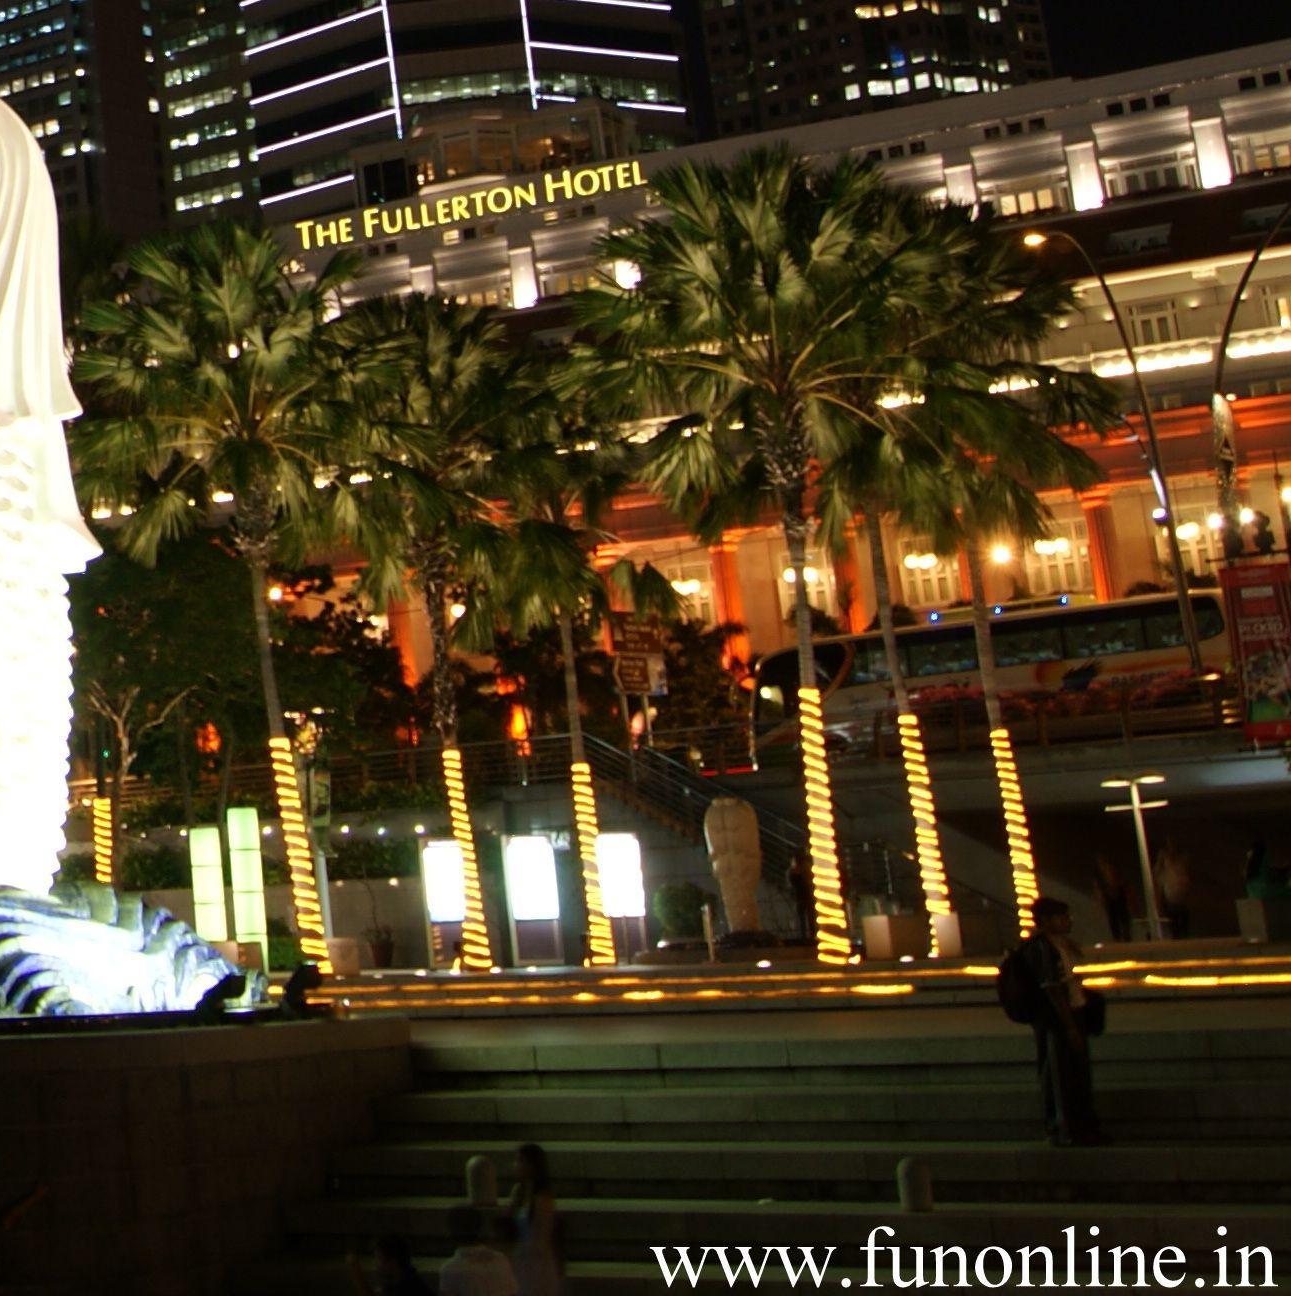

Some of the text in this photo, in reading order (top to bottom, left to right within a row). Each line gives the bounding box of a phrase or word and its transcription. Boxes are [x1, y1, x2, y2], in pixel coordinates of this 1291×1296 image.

[295, 160, 649, 250] THE FULLERTON HOTEL
